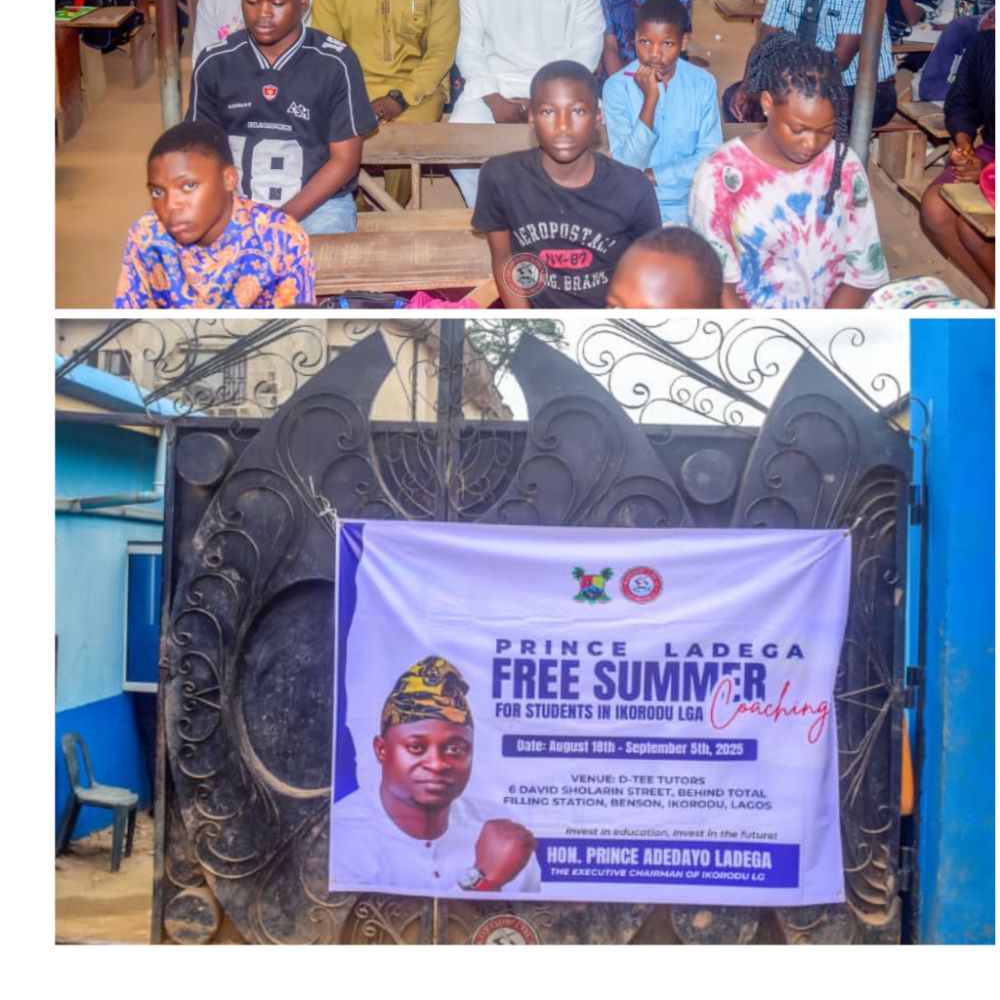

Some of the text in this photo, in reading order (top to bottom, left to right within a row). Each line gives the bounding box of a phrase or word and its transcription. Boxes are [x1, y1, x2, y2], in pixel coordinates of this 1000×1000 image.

[496, 638, 804, 660] PRINCE LADEGA
[492, 657, 767, 702] FREE SUMMER
[495, 702, 704, 722] FOR STUDENTS IN IKORODU LGA
[710, 679, 830, 745] Coaching
[516, 738, 547, 753] Date:
[549, 739, 589, 755] August
[592, 740, 616, 754] 18th
[625, 740, 688, 757] September
[690, 741, 713, 756] 5th,
[715, 742, 744, 756] 2025
[570, 773, 706, 786] VENUE: D-TEE TUTORS
[508, 784, 767, 799] 6 DAVID SHOLARIN STREET, BEHIND TOTAL
[503, 796, 773, 811] FILLING STATION, BENSON, IKORODU, LAGOS
[546, 845, 772, 869] HON. PRINCE ADEDAYO LADEGA
[550, 867, 569, 876] THE
[571, 868, 627, 878] EXECUTIVE
[628, 869, 683, 879] CHAIRMAN
[684, 871, 700, 879] OF
[701, 872, 750, 881] IKORODU
